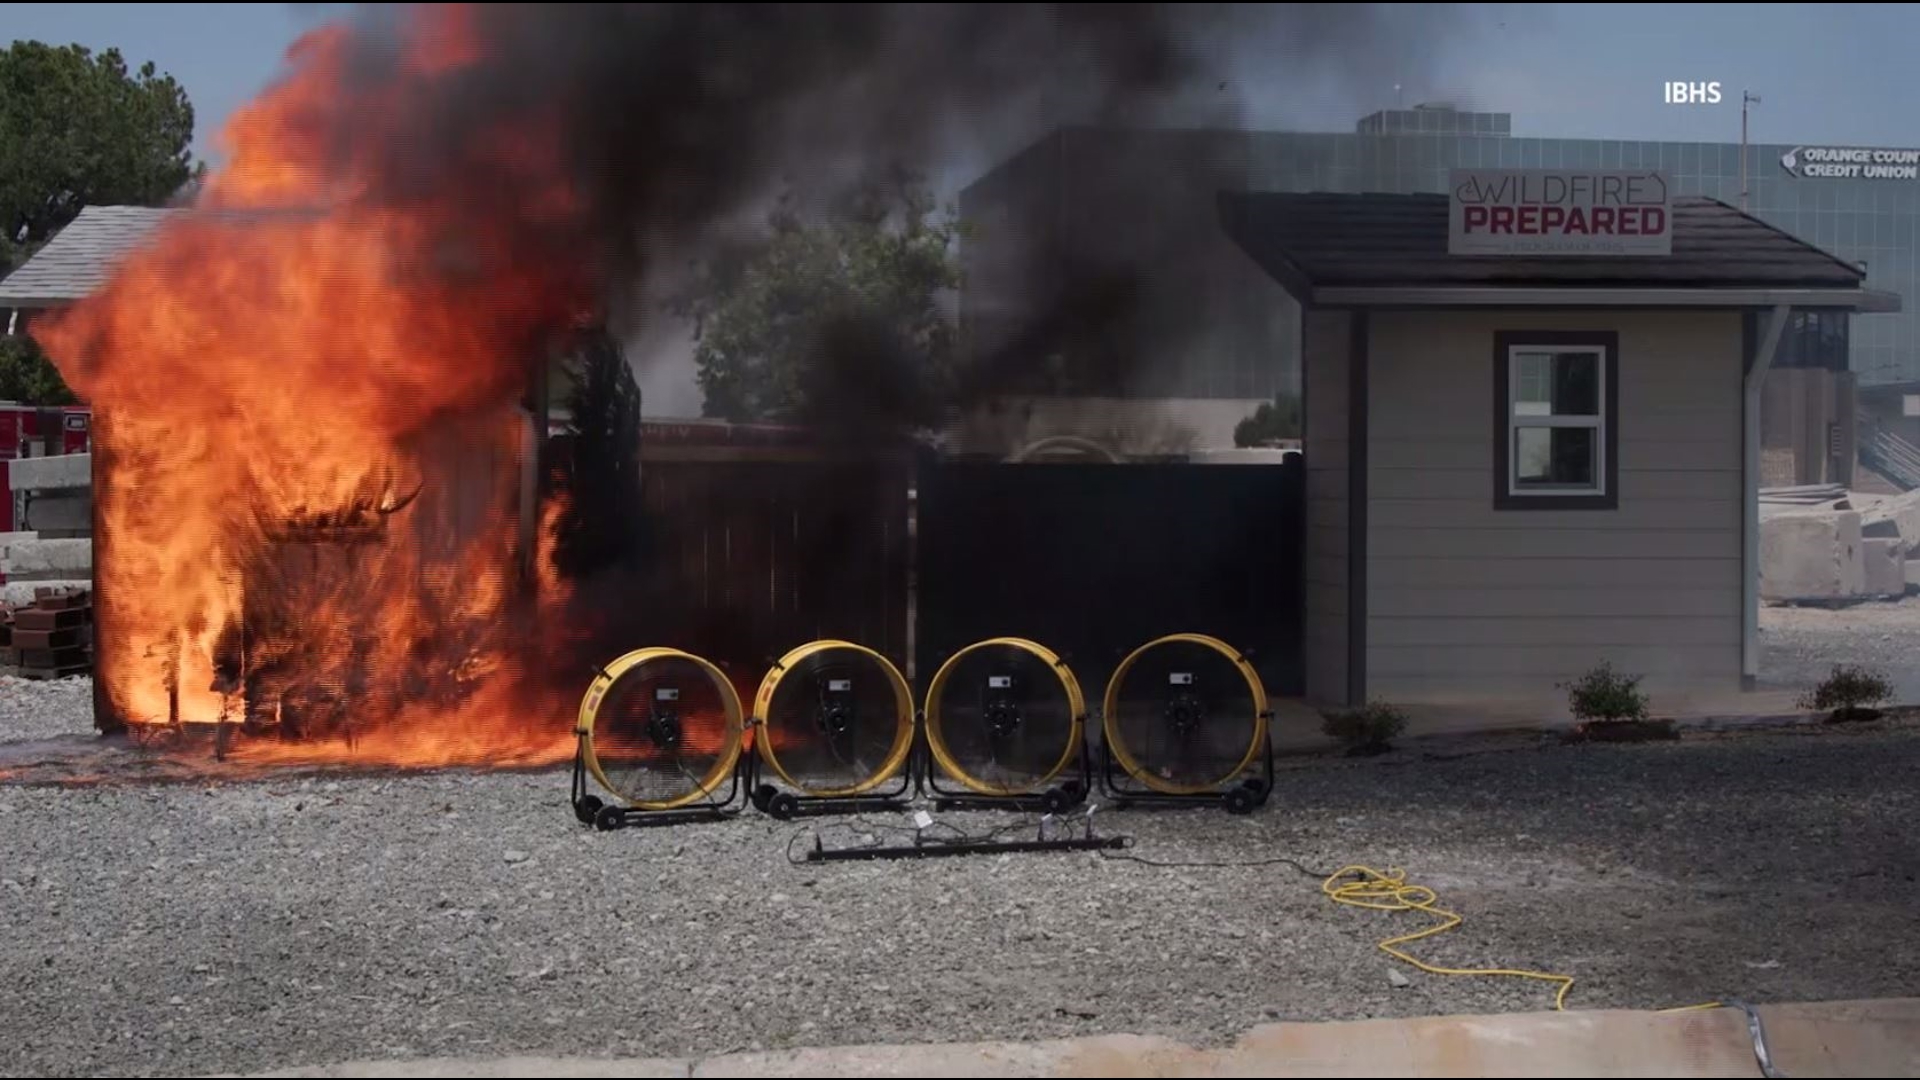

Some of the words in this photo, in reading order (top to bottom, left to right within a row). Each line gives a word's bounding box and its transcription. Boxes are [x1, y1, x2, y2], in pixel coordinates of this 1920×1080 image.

[1804, 148, 1871, 163] ORANGE
[1872, 150, 1920, 164] COUN
[1804, 164, 1861, 178] CREDIT
[1863, 165, 1918, 179] UNION
[1464, 175, 1656, 204] WILDFIRE
[1464, 207, 1666, 235] PREPARED
